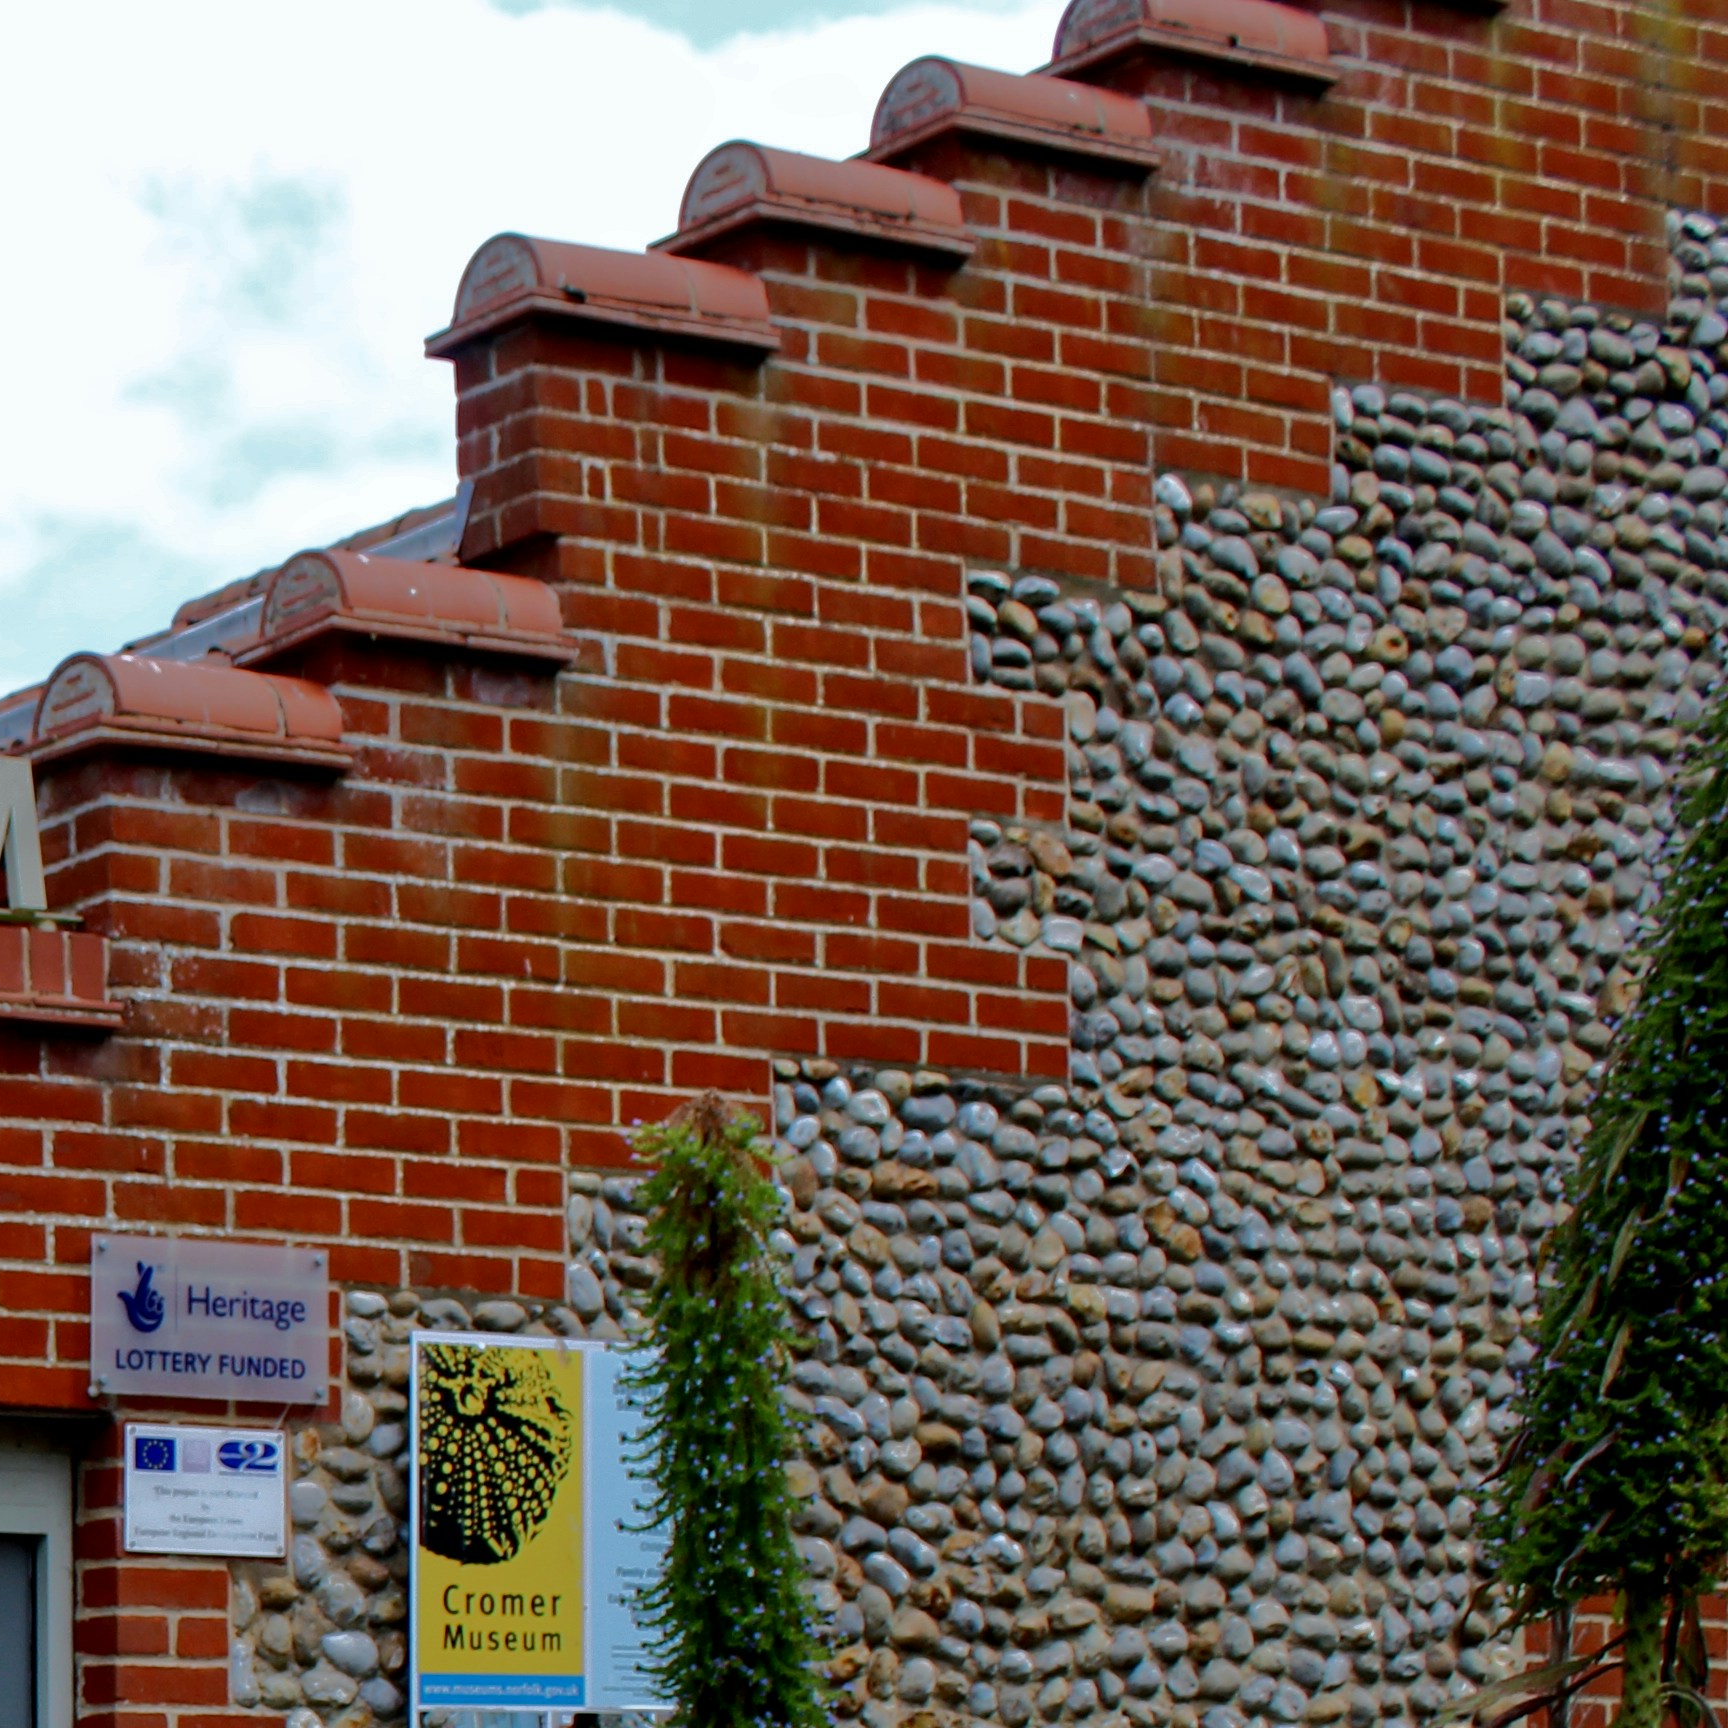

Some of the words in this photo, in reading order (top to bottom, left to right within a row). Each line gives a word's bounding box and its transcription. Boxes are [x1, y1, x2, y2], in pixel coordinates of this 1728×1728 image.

[187, 1285, 306, 1330] Heritage
[115, 1348, 211, 1375] LOTTERY
[218, 1354, 306, 1379] FUNDED
[443, 1584, 562, 1616] Cromer
[443, 1624, 562, 1651] Museum
[424, 1682, 580, 1699] www.museums.norfolk.gov.uk
